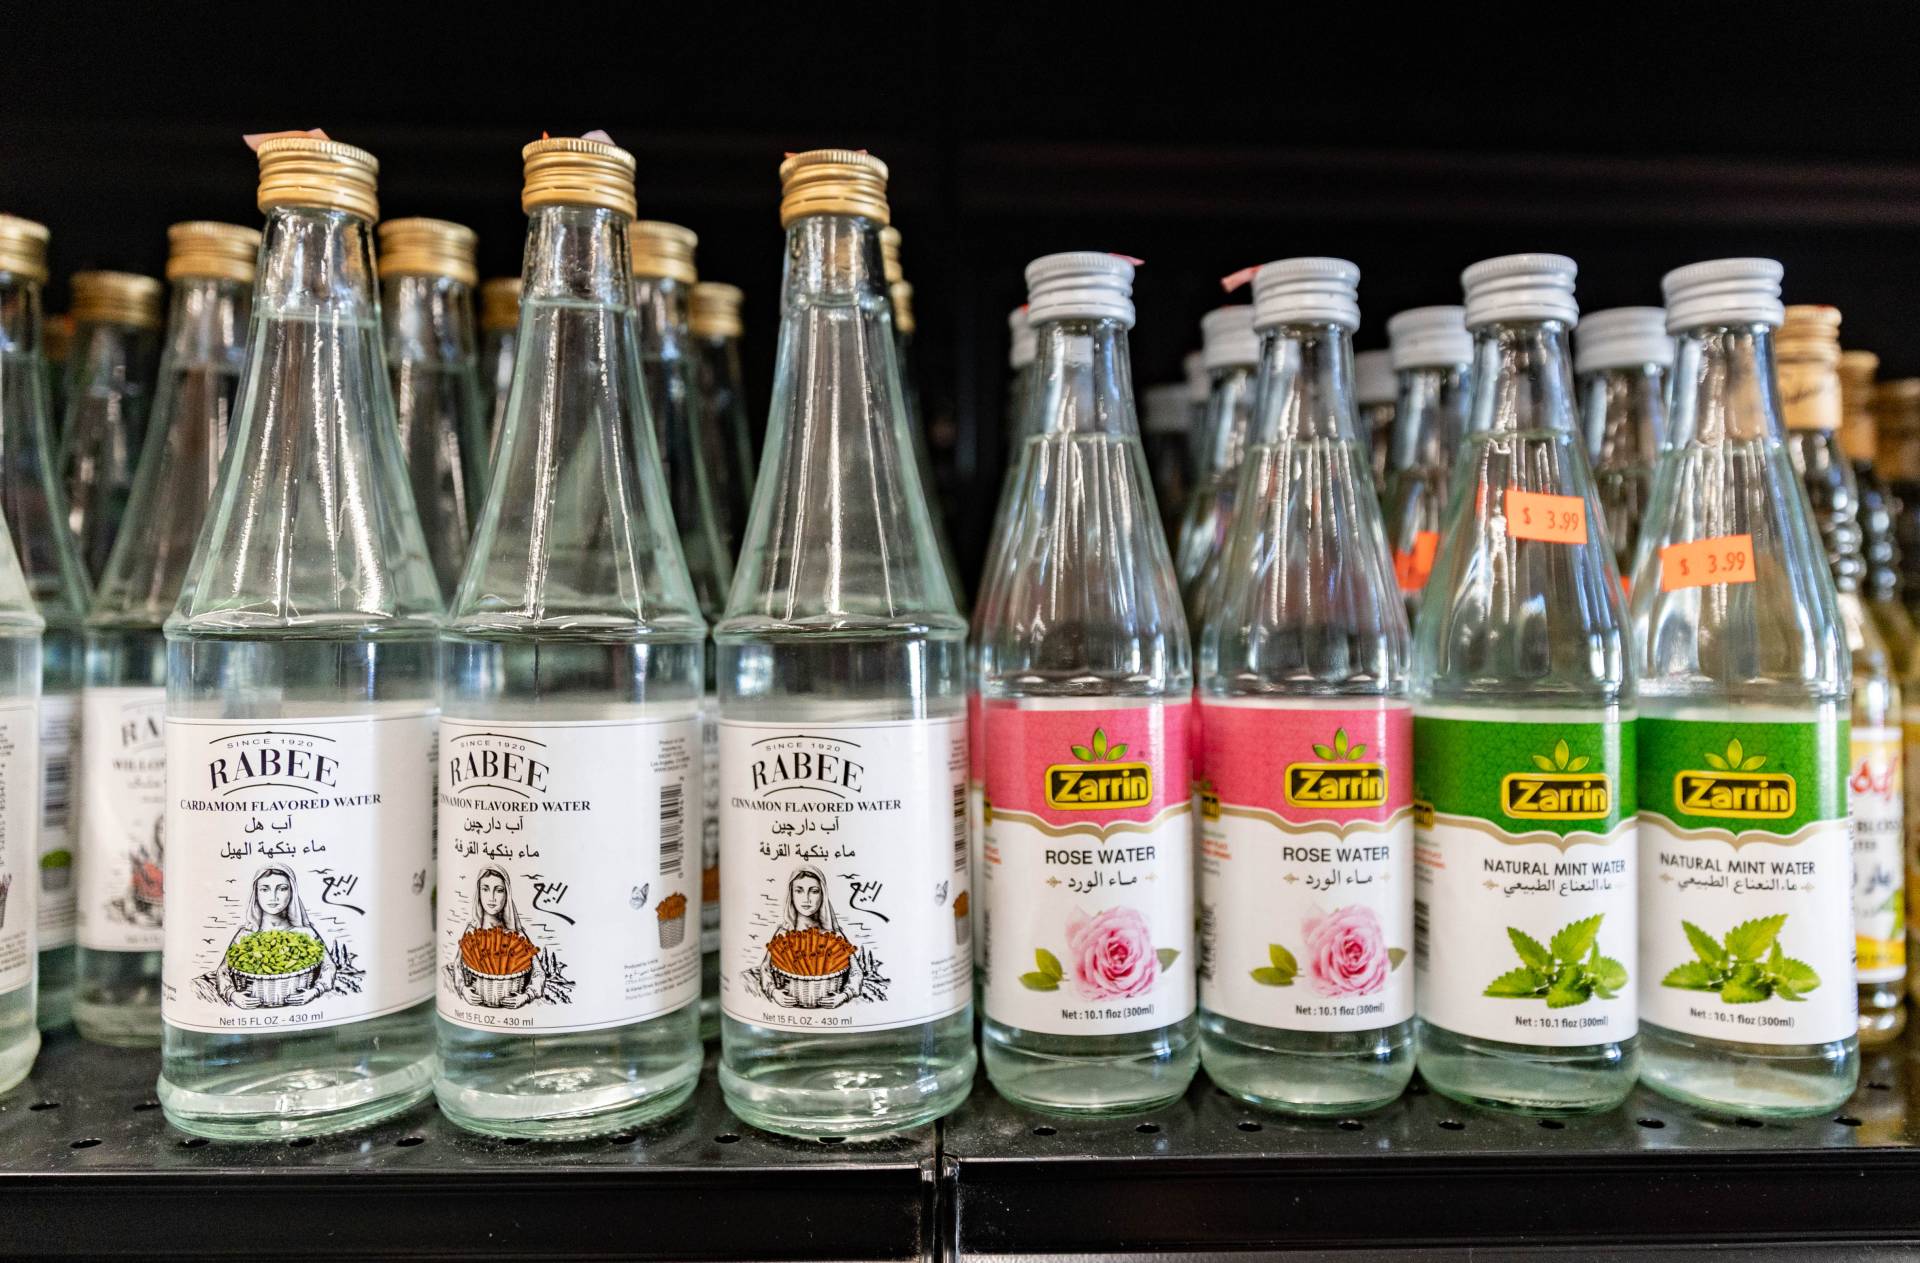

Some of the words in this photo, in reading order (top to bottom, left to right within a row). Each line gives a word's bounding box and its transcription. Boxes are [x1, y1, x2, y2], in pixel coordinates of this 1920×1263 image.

[1546, 510, 1580, 532] 3.99
[1707, 551, 1746, 574] 3.99
[227, 739, 271, 748] SINCE
[280, 739, 313, 748] 1920
[460, 740, 490, 748] SINCE
[498, 741, 526, 751] 1920
[766, 742, 803, 751] SINCE
[811, 743, 841, 752] 1920
[209, 749, 339, 791] RABEE
[450, 750, 550, 793] RABEE
[751, 752, 865, 793] RABEE
[1054, 770, 1148, 803] Zarrin
[1294, 769, 1384, 801] Zarrin
[180, 799, 247, 812] CARDAMOM
[252, 798, 330, 811] FLAVORED
[334, 793, 381, 807] WATER
[1511, 781, 1608, 812] Zarrin
[1684, 779, 1789, 812] Zarrin
[474, 800, 538, 812] FLAVORED
[542, 801, 591, 812] WATER
[732, 797, 782, 812] CINNAMON
[785, 802, 854, 813] FLAVORED
[857, 799, 902, 811] WATER
[244, 817, 265, 834] هل
[271, 815, 292, 834] آب
[505, 816, 524, 834] آب
[821, 816, 840, 834] آب
[258, 841, 296, 859] بنكهة
[303, 840, 326, 855] ماء
[483, 843, 514, 861] بنكهة
[518, 844, 540, 859] ماء
[759, 841, 791, 861] القرفة
[795, 844, 829, 861] بنكهة
[834, 844, 856, 859] ماء
[1045, 850, 1093, 865] ROSE
[1097, 846, 1156, 865] WATER
[1282, 847, 1331, 862] ROSE
[1336, 846, 1390, 863] WATER
[1484, 858, 1549, 876] NATURAL
[1554, 862, 1588, 876] MINT
[1592, 860, 1626, 875] WATER
[1660, 852, 1722, 872] NATURAL
[1728, 860, 1766, 874] MINT
[1771, 861, 1816, 875] WATER
[1068, 871, 1104, 894] الورد
[1109, 870, 1138, 888] ماء
[1306, 869, 1341, 891] الورد
[1346, 868, 1373, 885] ماء
[220, 1017, 235, 1026] Net
[238, 1018, 247, 1026] 15
[250, 1017, 262, 1025] FL
[264, 1016, 278, 1025] OZ
[288, 1013, 308, 1022] 430
[311, 1011, 324, 1021] ml
[454, 1009, 464, 1019] Net
[466, 1012, 472, 1020] 15
[473, 1013, 482, 1023] FL
[484, 1015, 496, 1024] OZ
[503, 1017, 520, 1026] 430
[522, 1018, 534, 1026] ml
[762, 1012, 776, 1022] Net
[777, 1015, 785, 1024] 15
[788, 1016, 798, 1024] FL
[800, 1016, 812, 1025] OZ
[820, 1017, 838, 1025] 430
[840, 1017, 852, 1025] ml
[1062, 1009, 1077, 1020] Net
[1084, 1010, 1103, 1020] 10.1
[1123, 1004, 1155, 1019] (300ml)
[1296, 1005, 1311, 1015] Net
[1319, 1006, 1337, 1016] 10.1
[1356, 1003, 1385, 1016] (300ml)
[1690, 1007, 1706, 1018] Net
[1714, 1012, 1734, 1023] 10.1
[1757, 1015, 1795, 1028] (300ml)
[1515, 1016, 1532, 1027] Net
[1540, 1018, 1559, 1028] 10.1
[1579, 1016, 1609, 1028] (300ml)
